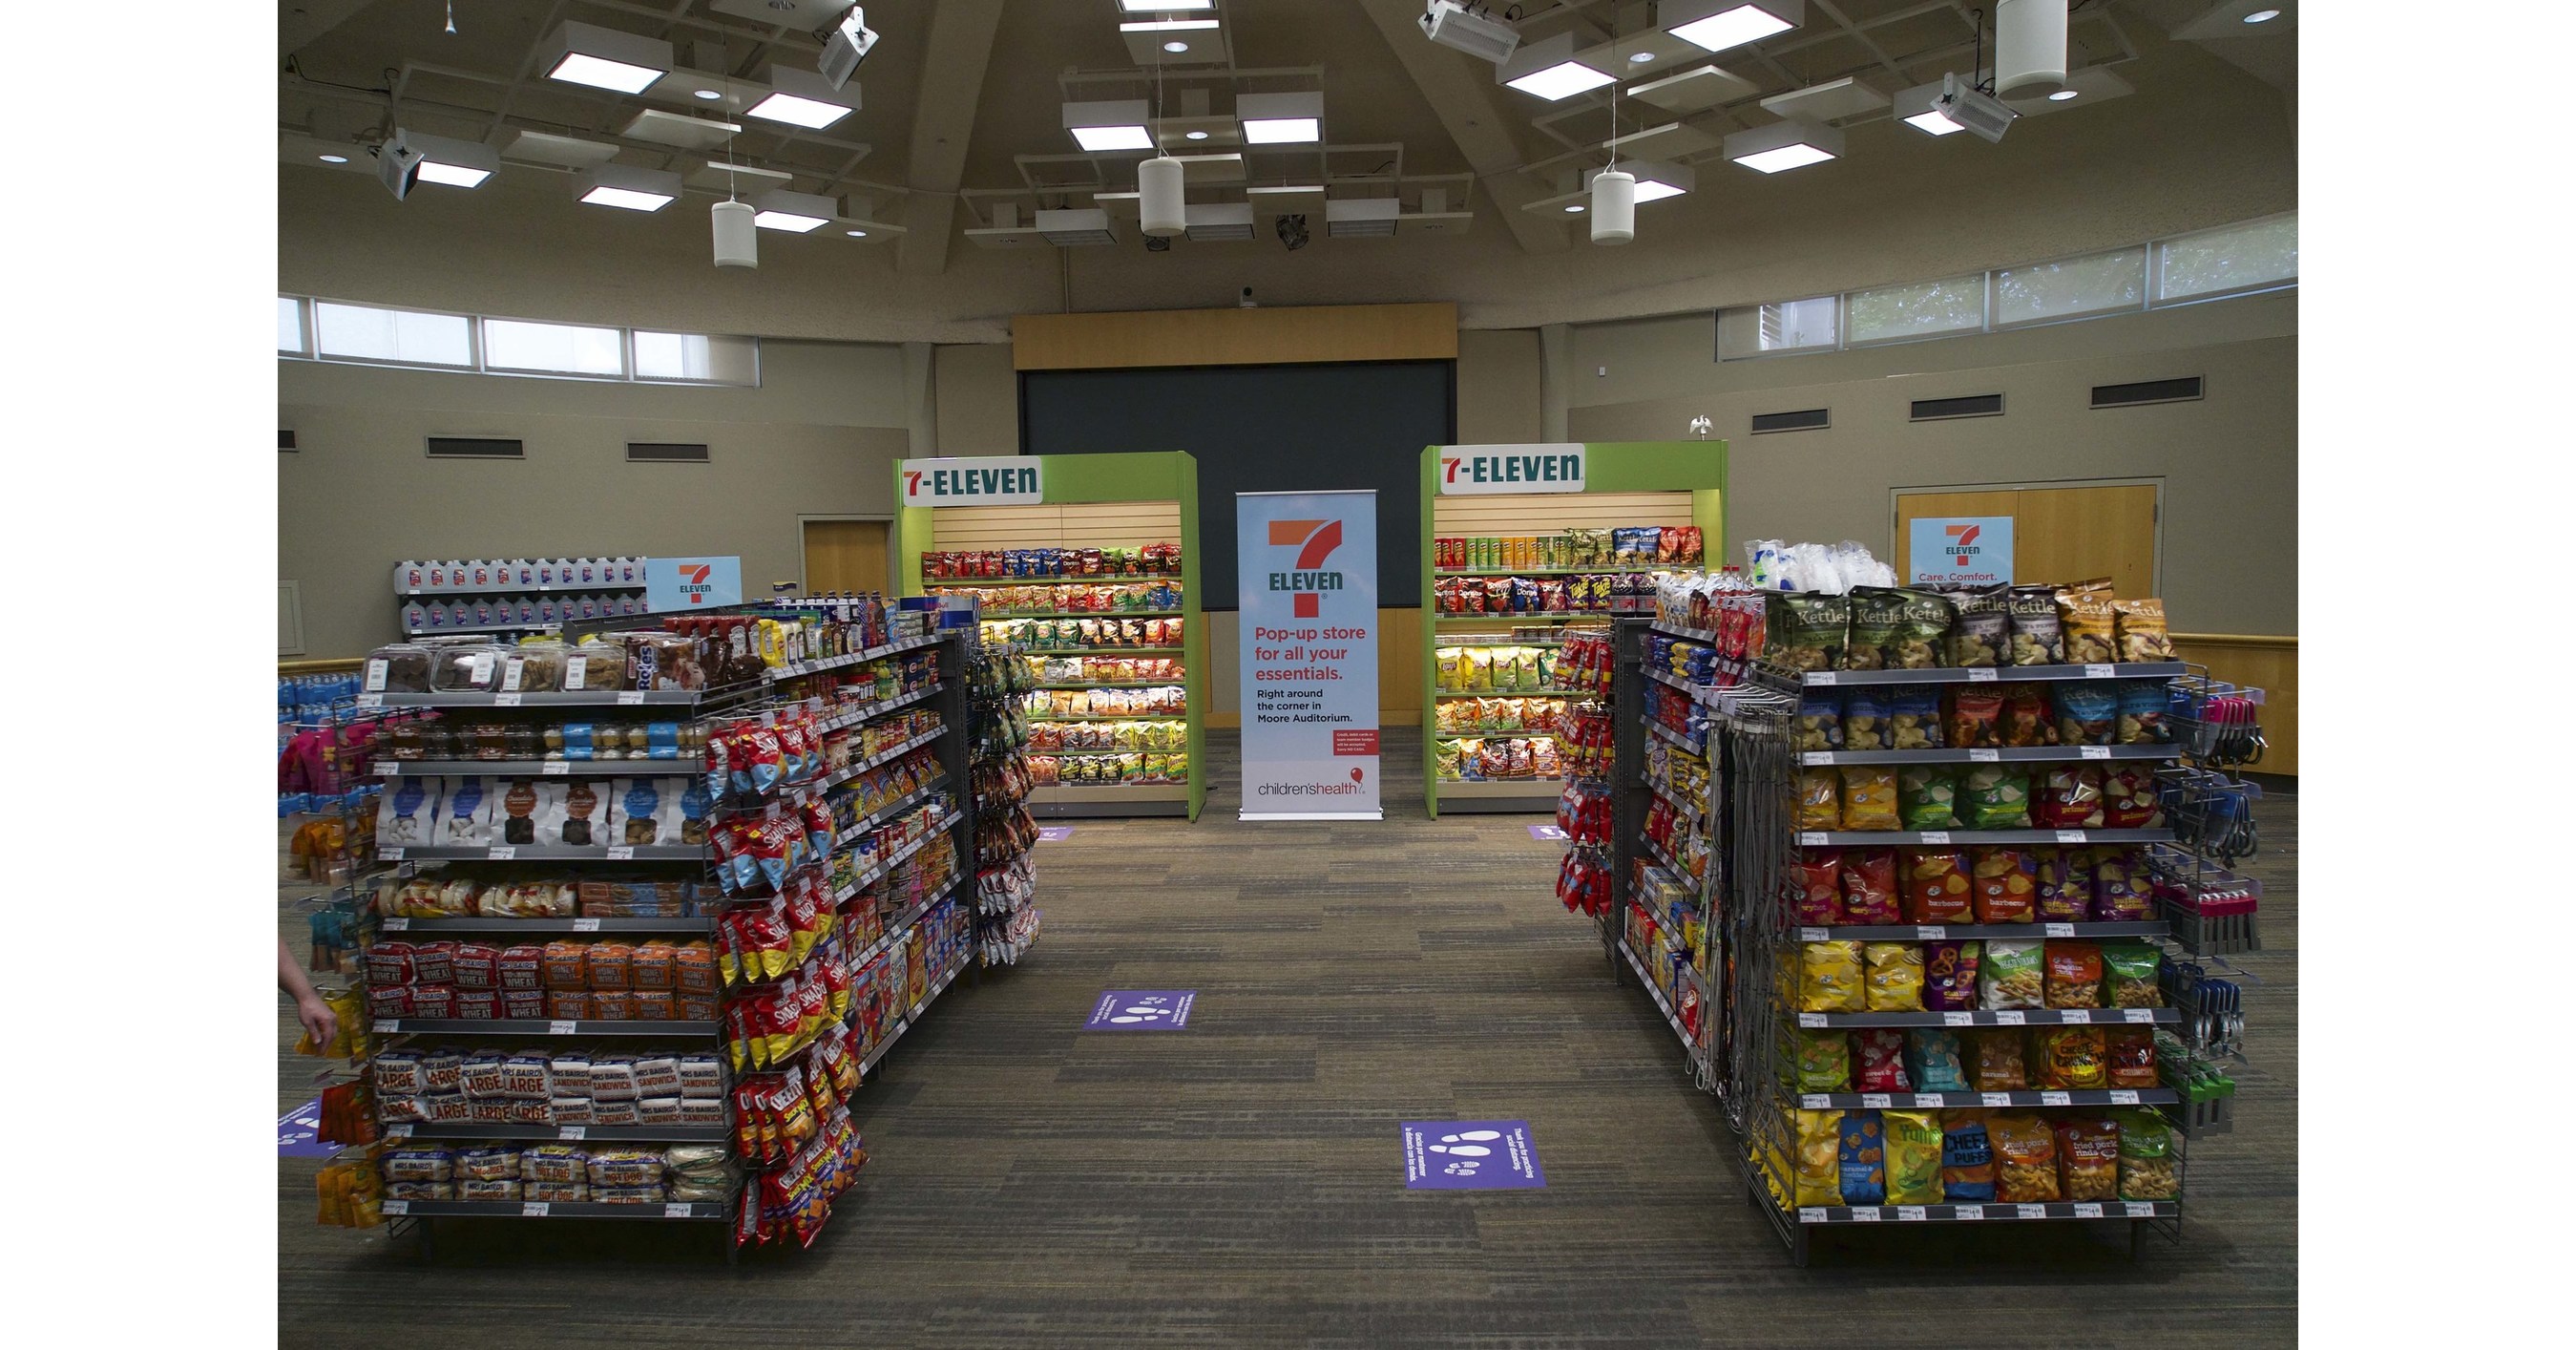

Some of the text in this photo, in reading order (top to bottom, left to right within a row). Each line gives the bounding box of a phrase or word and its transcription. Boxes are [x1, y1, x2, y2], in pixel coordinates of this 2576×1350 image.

[1918, 572, 1998, 581] Care. Comfort.
[1958, 597, 2007, 615] Kettle
[2009, 599, 2056, 615] Kettle
[2070, 600, 2115, 616] Kettle
[1798, 608, 1845, 626] Kettle
[1857, 607, 1903, 624] Kettle
[1902, 605, 1952, 627] Kettle
[1255, 626, 1366, 643] Pop-up store
[1255, 645, 1348, 663] for all your
[1255, 665, 1343, 681] essentials.
[1257, 688, 1324, 700] Right around
[1257, 702, 1322, 710] the corner in
[1257, 713, 1353, 723] Moore Auditorium.
[1928, 899, 1964, 908] barbecue
[1988, 898, 2026, 908] barbecue
[2017, 955, 2039, 965] STRAWS
[371, 972, 402, 982] WHEAT
[421, 969, 452, 981] WHEAT
[639, 968, 664, 977] HONEY
[683, 970, 709, 980] HONEY
[457, 974, 489, 985] WHEAT
[505, 978, 536, 988] WHEAT
[558, 1002, 583, 1011] HONEY
[417, 1008, 448, 1019] WHEAT
[460, 1008, 492, 1019] WHEAT
[511, 1007, 541, 1018] WHEAT
[472, 1068, 498, 1077] BAIRD'S
[515, 1068, 543, 1077] BAIRD'S
[649, 1066, 673, 1075] BAIRD'S
[375, 1073, 415, 1087] LARGE
[504, 1078, 545, 1093] LARGE
[593, 1081, 632, 1090] SANDWICH
[637, 1075, 678, 1087] SANDWICH
[681, 1079, 721, 1087] SANDWICH
[381, 1100, 418, 1118] LARGE
[430, 1103, 470, 1120] LARGE
[472, 1106, 512, 1120] LARGE
[512, 1105, 549, 1120] LARGE
[606, 1104, 631, 1112] BAIRD'S
[653, 1105, 677, 1113] BAIRD'S
[555, 1111, 593, 1121] SANDWICH
[642, 1114, 681, 1123] SANDWICH
[682, 1113, 724, 1122] SANDWICH
[1514, 1128, 1523, 1140] Thank
[2027, 1138, 2049, 1149] pork
[2074, 1140, 2118, 1150] fried pork
[1956, 1151, 1993, 1164] PUFFS
[535, 1168, 570, 1178] HOT DOG
[605, 1172, 642, 1182] HOT DOG
